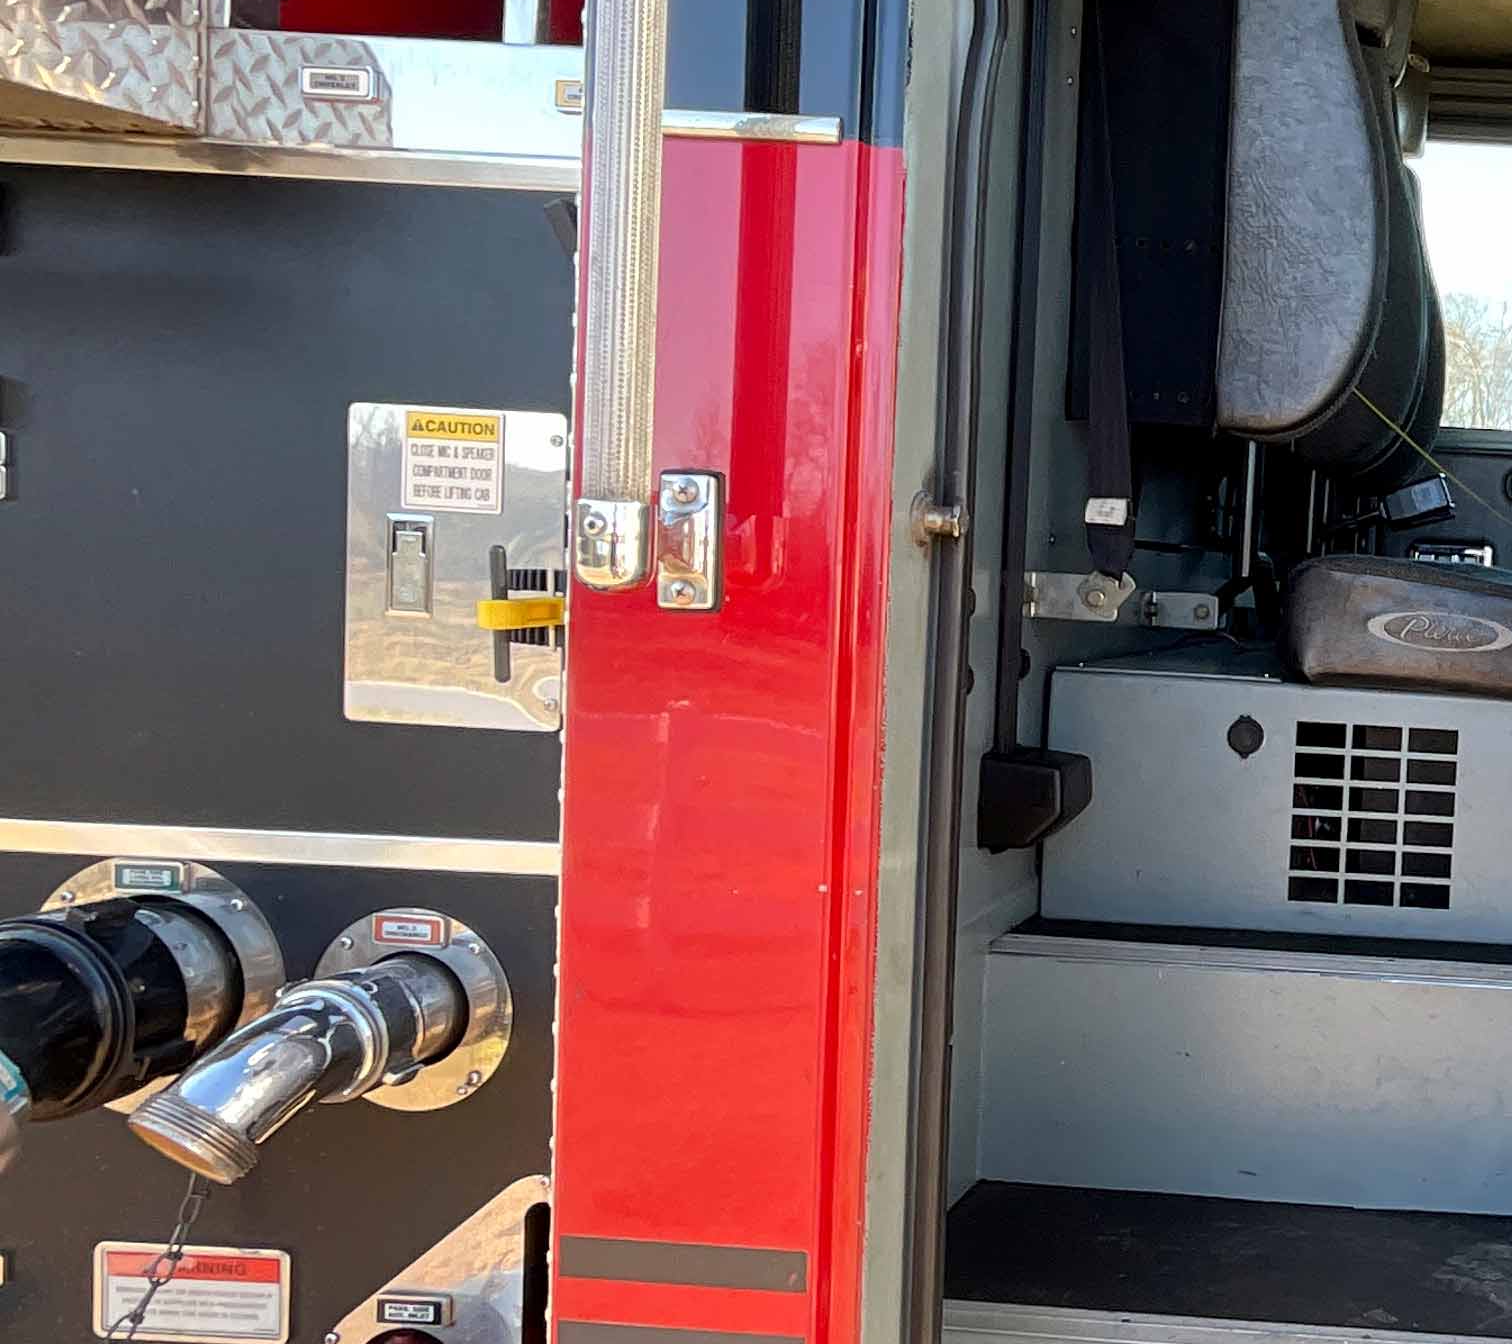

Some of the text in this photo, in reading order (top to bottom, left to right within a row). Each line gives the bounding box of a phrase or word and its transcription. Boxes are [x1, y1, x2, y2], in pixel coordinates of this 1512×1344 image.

[425, 419, 496, 436] CAUTION
[411, 443, 434, 458] CLOSE
[462, 446, 495, 461] SPEAKER
[413, 464, 492, 481] COMPARTMENT DOOR
[413, 484, 490, 501] BEFORE LIFTING CAB
